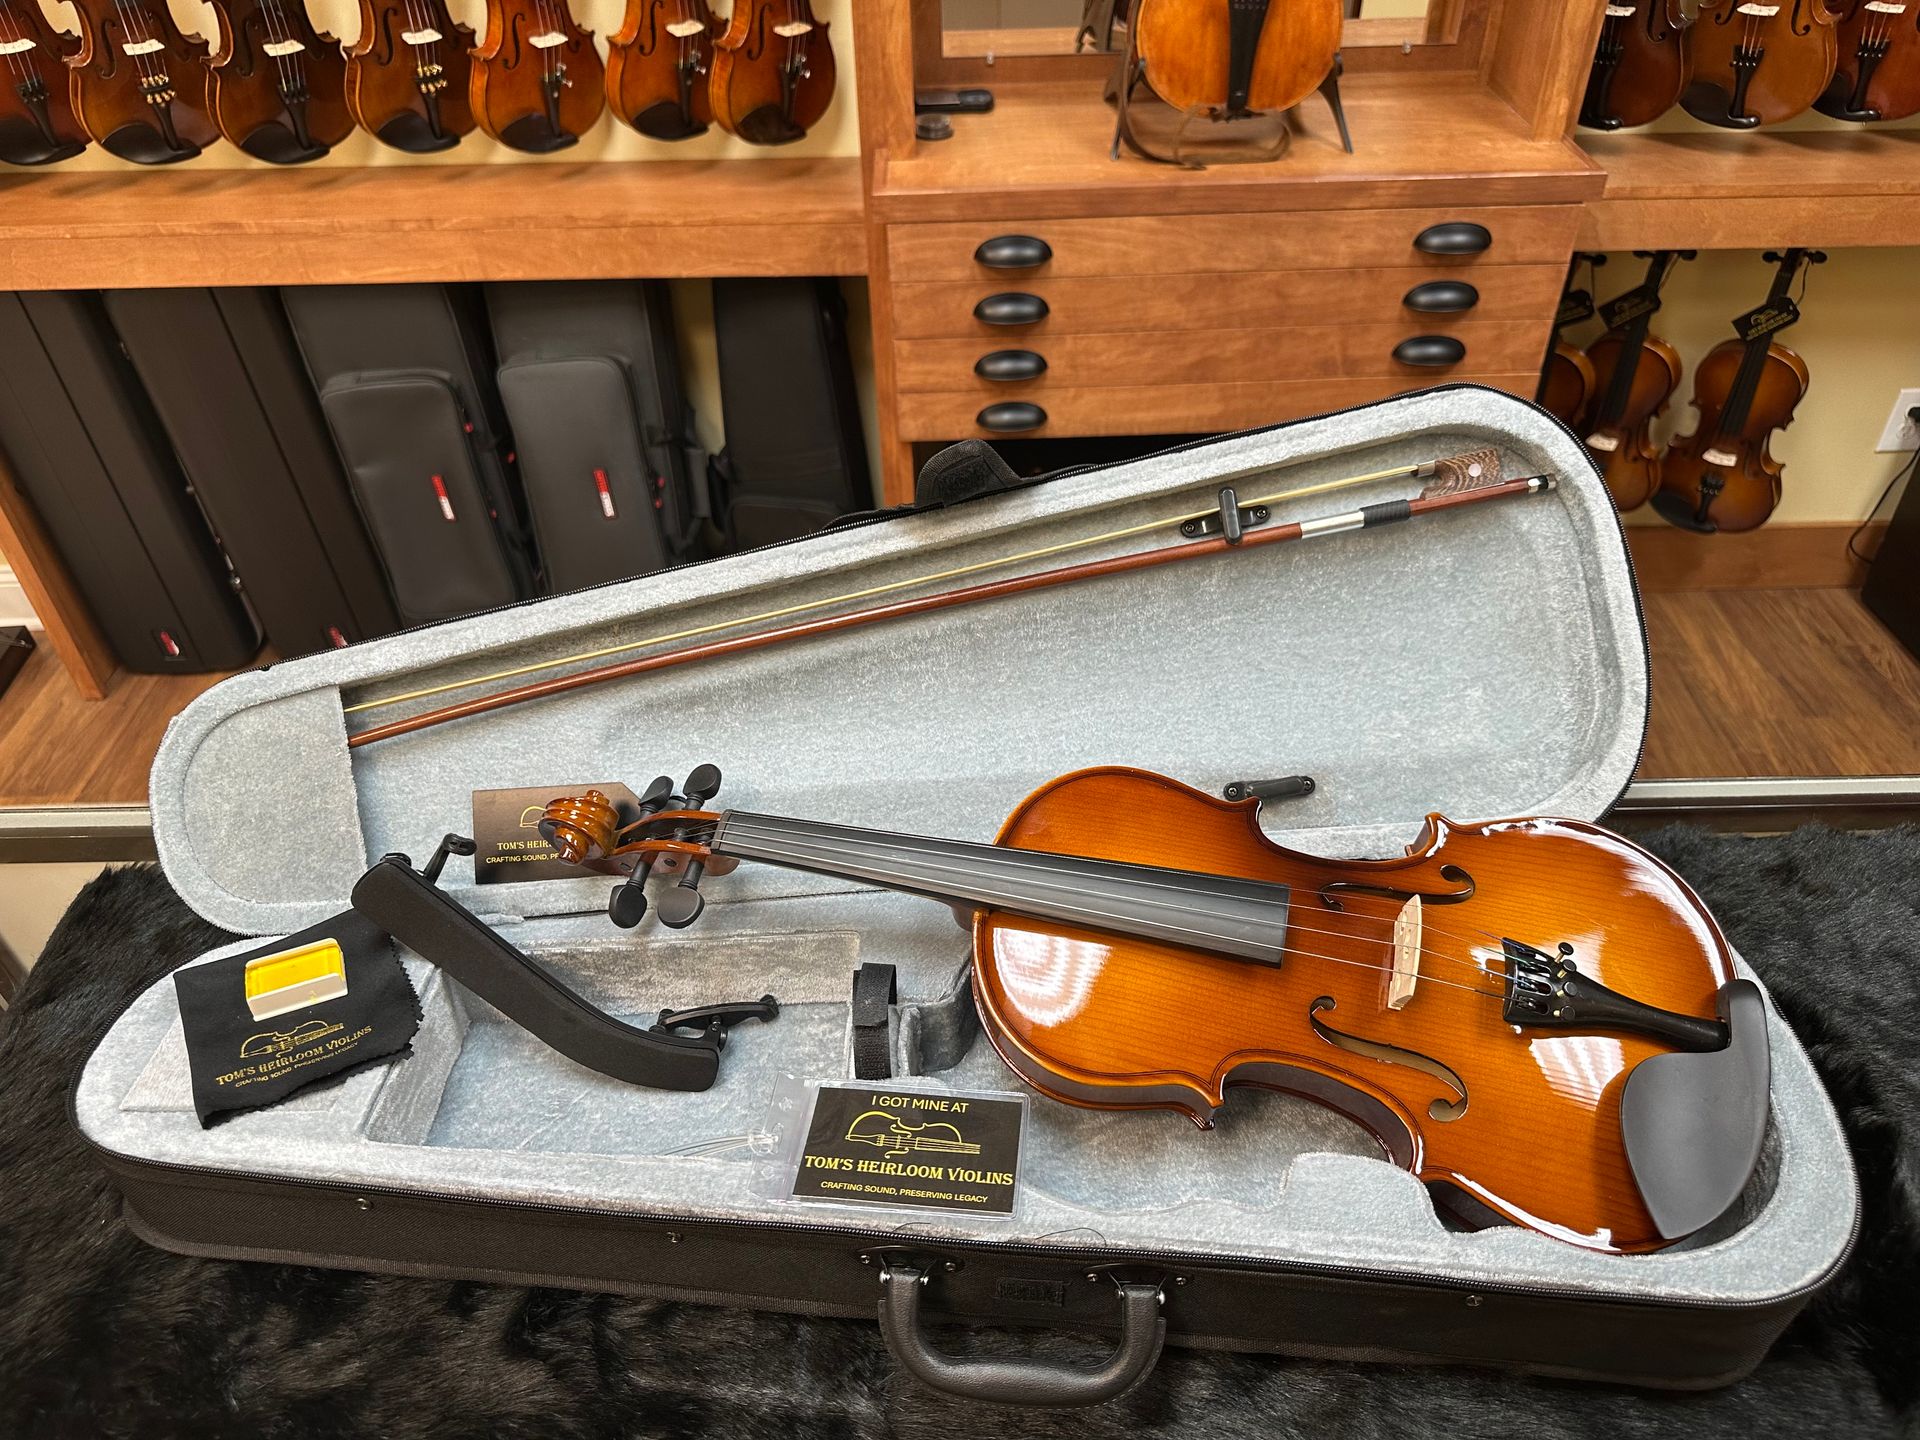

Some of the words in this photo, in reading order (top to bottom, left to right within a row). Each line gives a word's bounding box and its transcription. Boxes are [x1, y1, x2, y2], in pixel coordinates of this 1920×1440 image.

[497, 841, 525, 850] TOM'S
[527, 840, 552, 849] HEIR
[486, 855, 521, 864] CRAFTING
[522, 853, 549, 862] SOUND,
[216, 1067, 256, 1085] TOM'S
[258, 1046, 324, 1074] HEIRLOOM
[326, 1025, 372, 1050] VIOLINS
[872, 1095, 877, 1106] I
[878, 1095, 911, 1109] GOT
[912, 1099, 949, 1112] MINE
[950, 1102, 969, 1113] AT
[805, 1155, 854, 1171] TOM'S
[856, 1160, 943, 1180] HEIRLOOM
[947, 1167, 1014, 1185] VIOLINS
[820, 1181, 863, 1191] CRAFTING
[864, 1185, 898, 1196] SOUND,
[899, 1188, 953, 1200] PRESERVING
[954, 1194, 988, 1204] LEGACY
